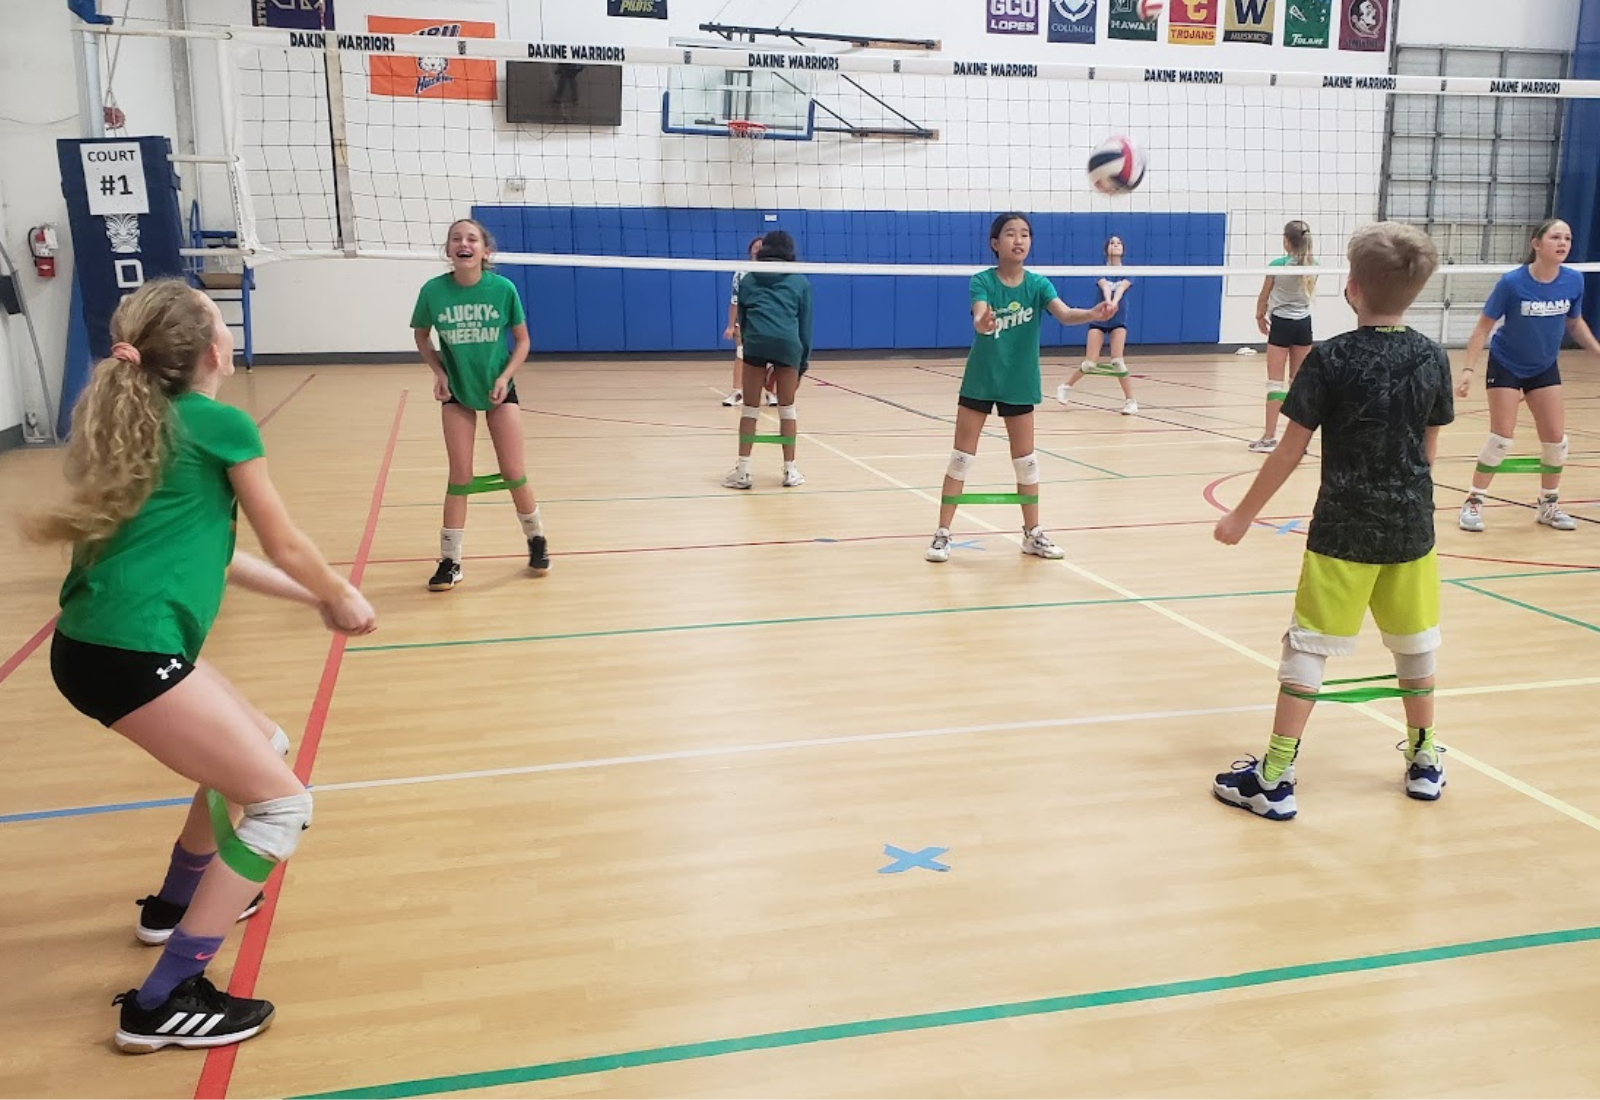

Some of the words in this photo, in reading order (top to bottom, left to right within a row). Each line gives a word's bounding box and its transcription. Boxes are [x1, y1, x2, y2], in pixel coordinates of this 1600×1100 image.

[620, 0, 654, 13] PILOTS
[991, 19, 1035, 31] LOPES
[289, 32, 327, 49] DAKIN
[336, 34, 395, 52] WARRIORS
[1170, 29, 1214, 40] TROJANS
[527, 43, 567, 59] DAKINE
[570, 45, 625, 62] WARRIORS
[748, 53, 785, 68] DAKINE
[788, 55, 839, 70] WARRIORS
[953, 61, 988, 76] DAKINE
[990, 63, 1038, 78] WARRIORS
[1144, 68, 1177, 82] DAKINE
[1179, 70, 1223, 84] WARRIORS
[1322, 75, 1353, 88] DAKINE
[1355, 76, 1397, 90] WARRIORS
[1490, 80, 1519, 93] DAKINE
[1521, 81, 1561, 94] WARRIORS
[87, 150, 136, 162] COURT
[100, 174, 133, 196] #1
[1530, 299, 1571, 311] OHANA
[445, 303, 494, 324] LUCKY
[990, 306, 1033, 339] prite
